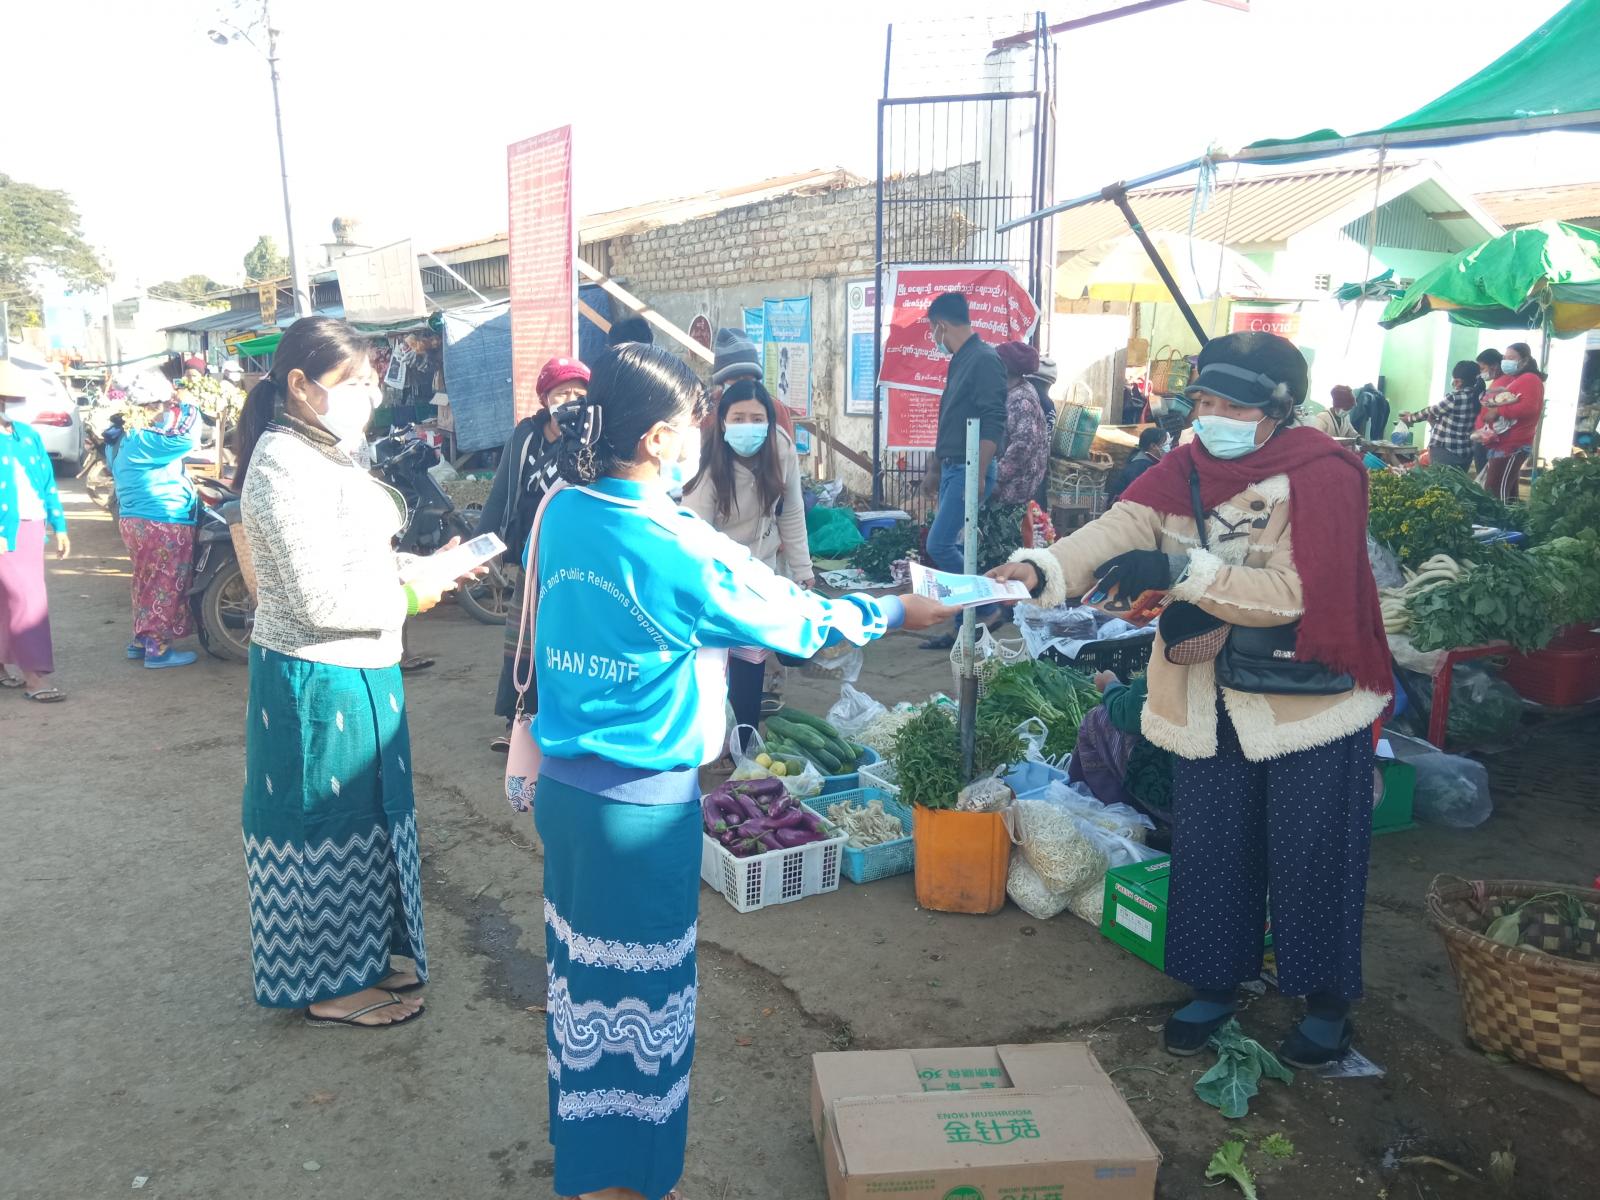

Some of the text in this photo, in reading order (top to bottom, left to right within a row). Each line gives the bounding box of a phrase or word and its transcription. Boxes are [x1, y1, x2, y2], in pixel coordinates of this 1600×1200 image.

[547, 571, 560, 589] and
[560, 568, 585, 582] Public
[587, 570, 630, 608] Relations
[630, 604, 672, 663] Departme
[588, 654, 640, 684] STATE
[937, 1109, 1033, 1120] ENOKI MUSHROOM
[943, 1118, 1041, 1142] 金针菇
